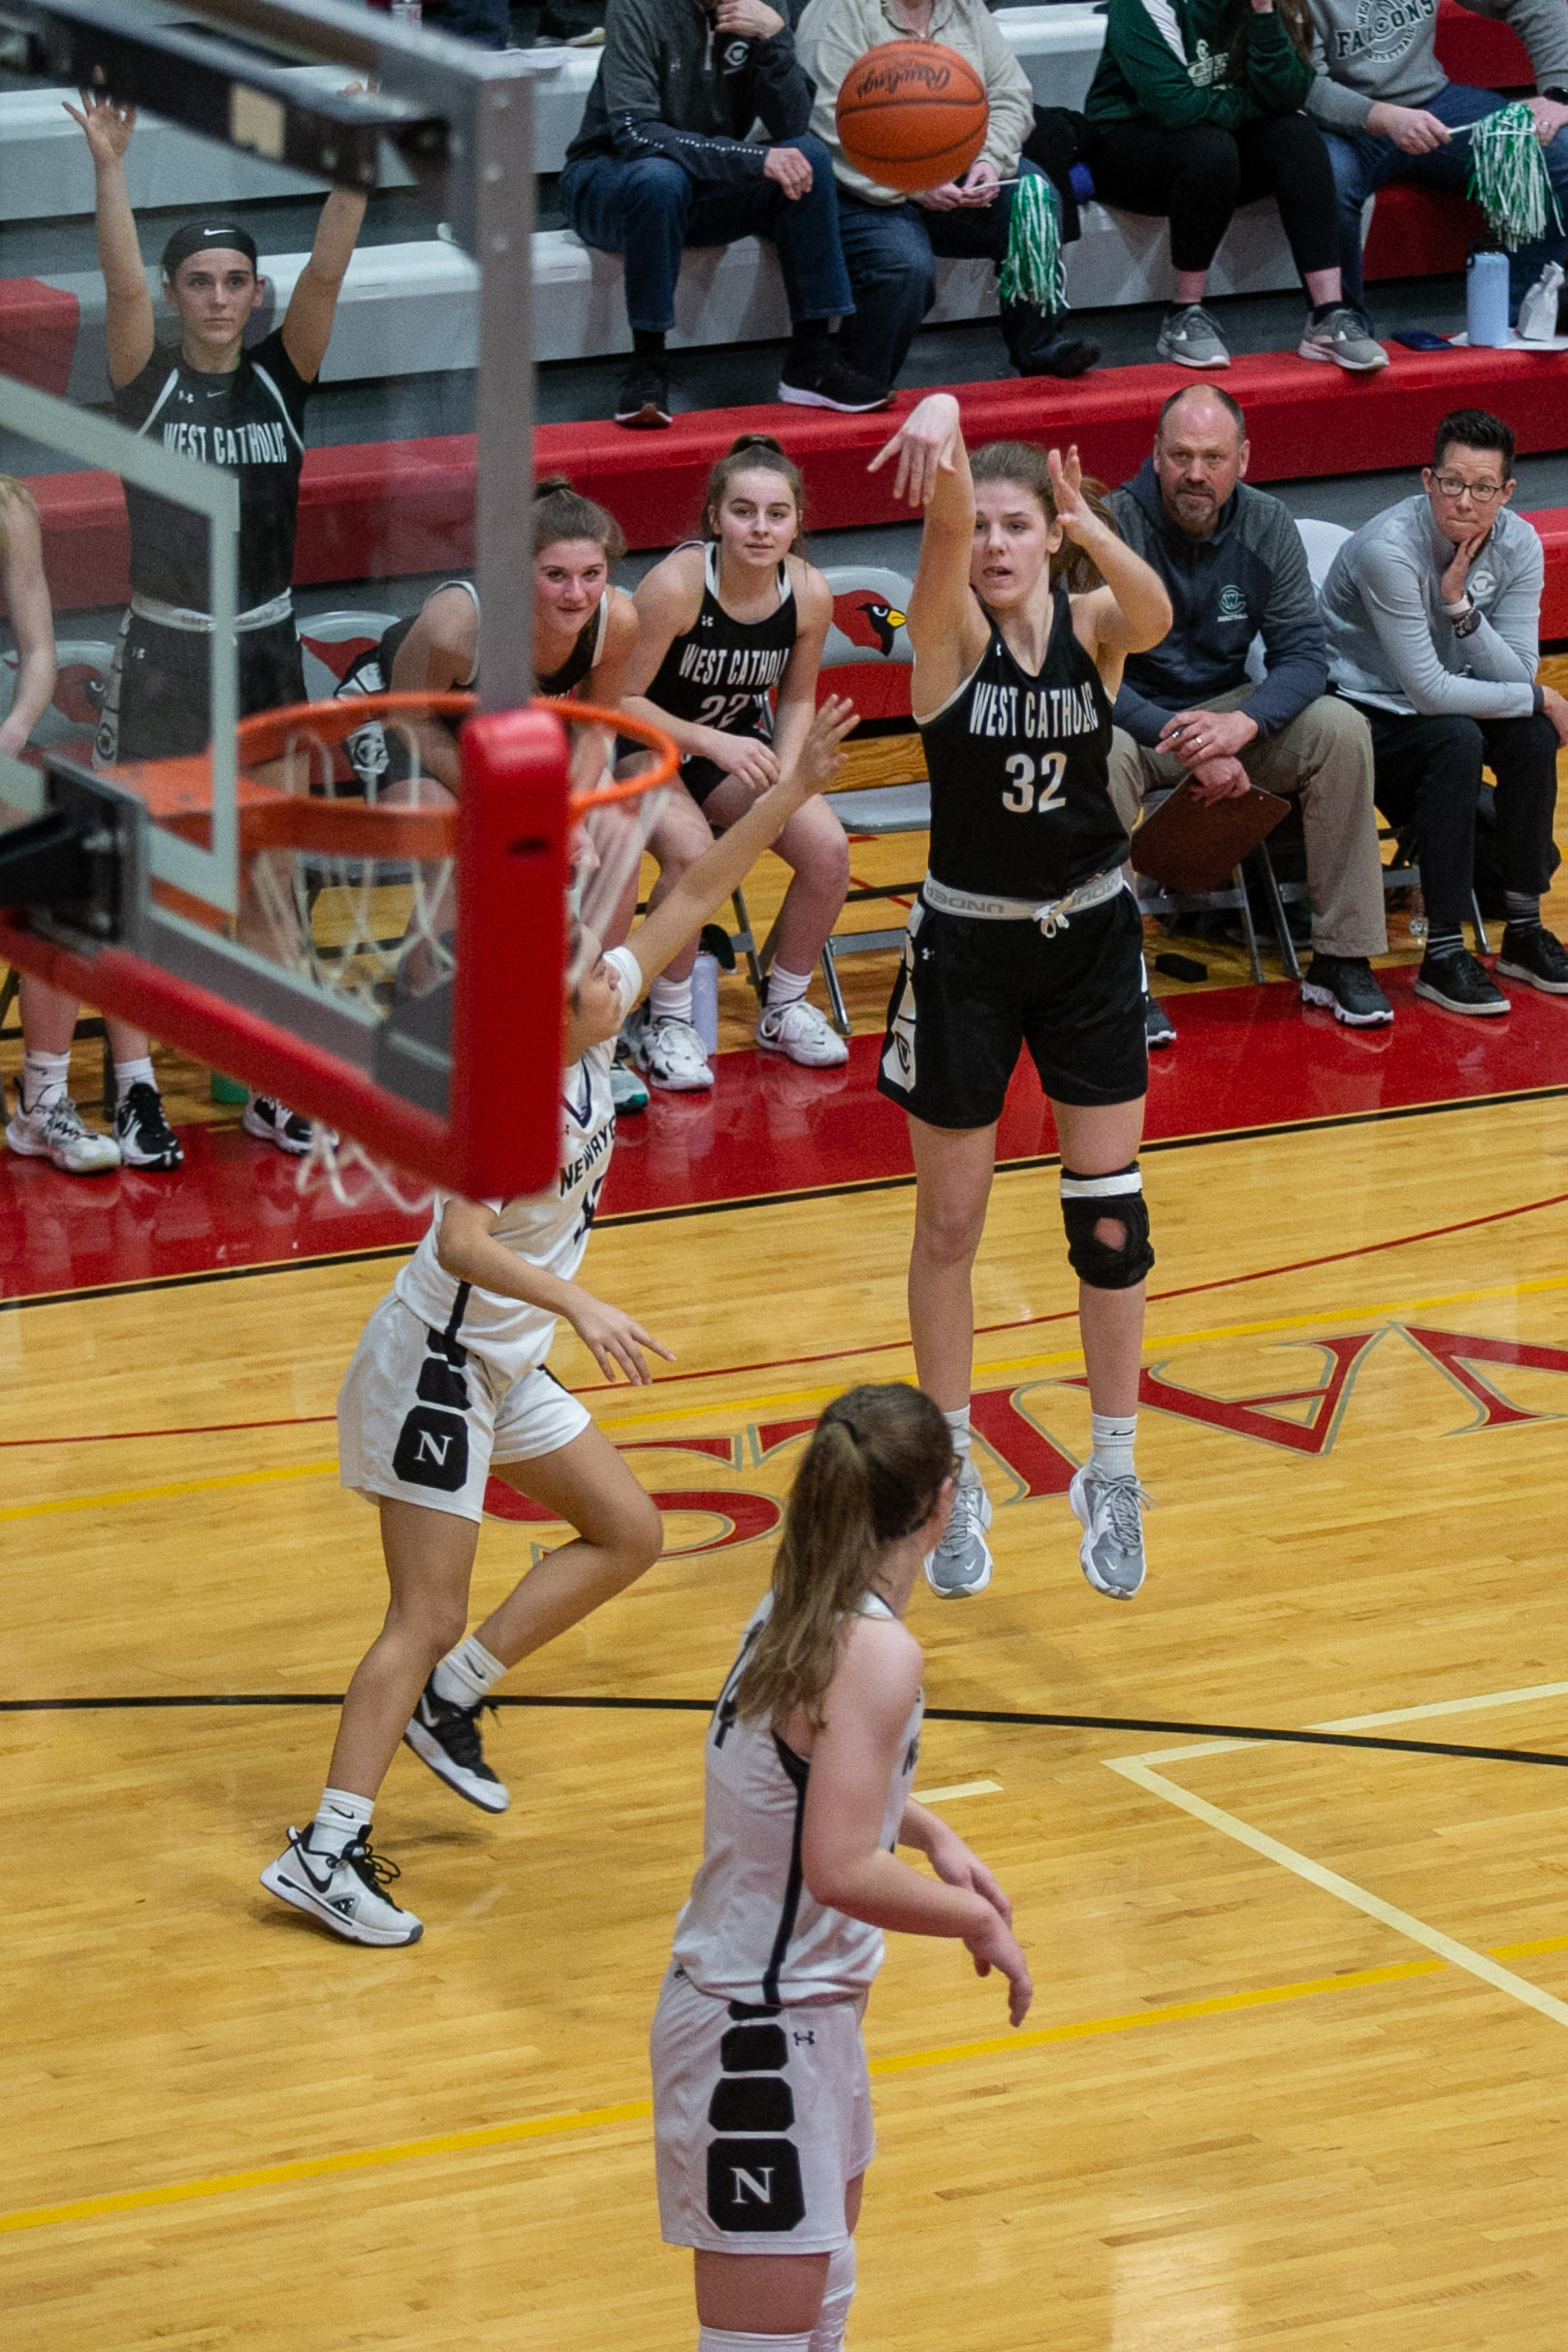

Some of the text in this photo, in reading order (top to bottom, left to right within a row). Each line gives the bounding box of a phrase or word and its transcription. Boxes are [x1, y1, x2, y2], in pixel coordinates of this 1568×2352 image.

[857, 64, 950, 99] Rawlings
[163, 421, 288, 465] WEST CATHOLIC
[679, 643, 728, 686] WEST
[692, 693, 752, 729] 22
[969, 681, 1018, 737] WEST
[1002, 752, 1068, 814] 32
[413, 1429, 454, 1466] N
[729, 2166, 775, 2204] N
